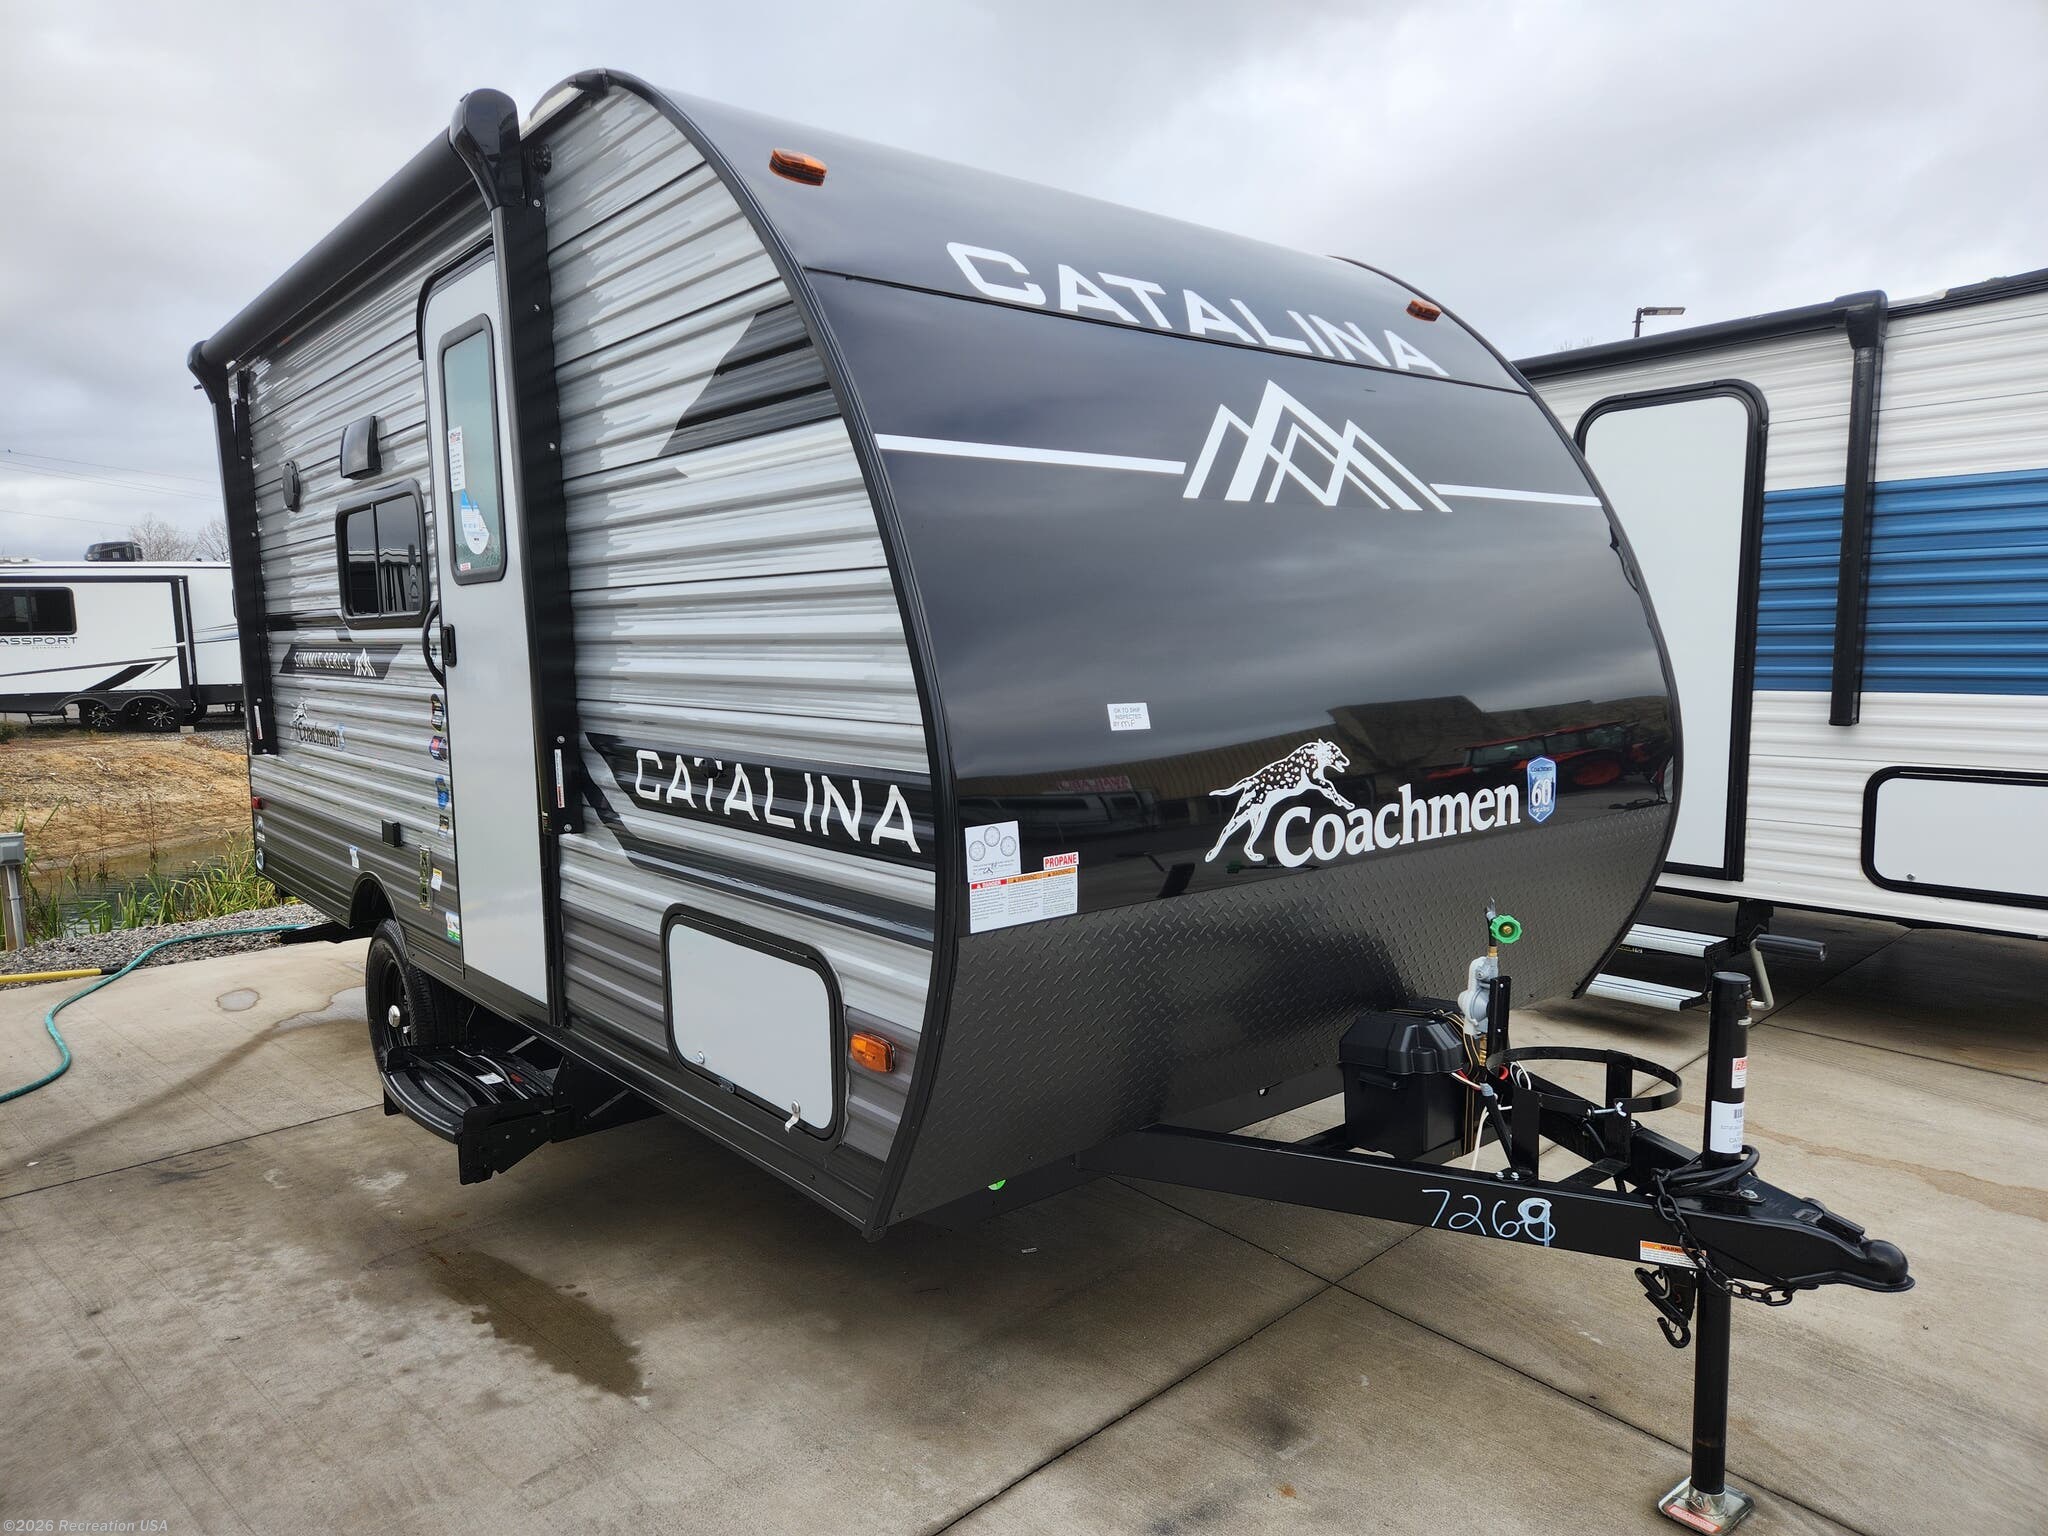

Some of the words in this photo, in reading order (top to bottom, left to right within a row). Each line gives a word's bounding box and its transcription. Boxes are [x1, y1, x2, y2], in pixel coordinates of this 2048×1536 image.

[946, 241, 1450, 377] CATALINA
[295, 651, 323, 667] SUMMIT
[324, 652, 351, 670] SERIES
[297, 721, 339, 748] Coachmen
[634, 748, 921, 854] CATALINA
[1531, 778, 1553, 807] 60
[1274, 783, 1521, 868] Coachmen
[1044, 854, 1078, 868] PROPANE
